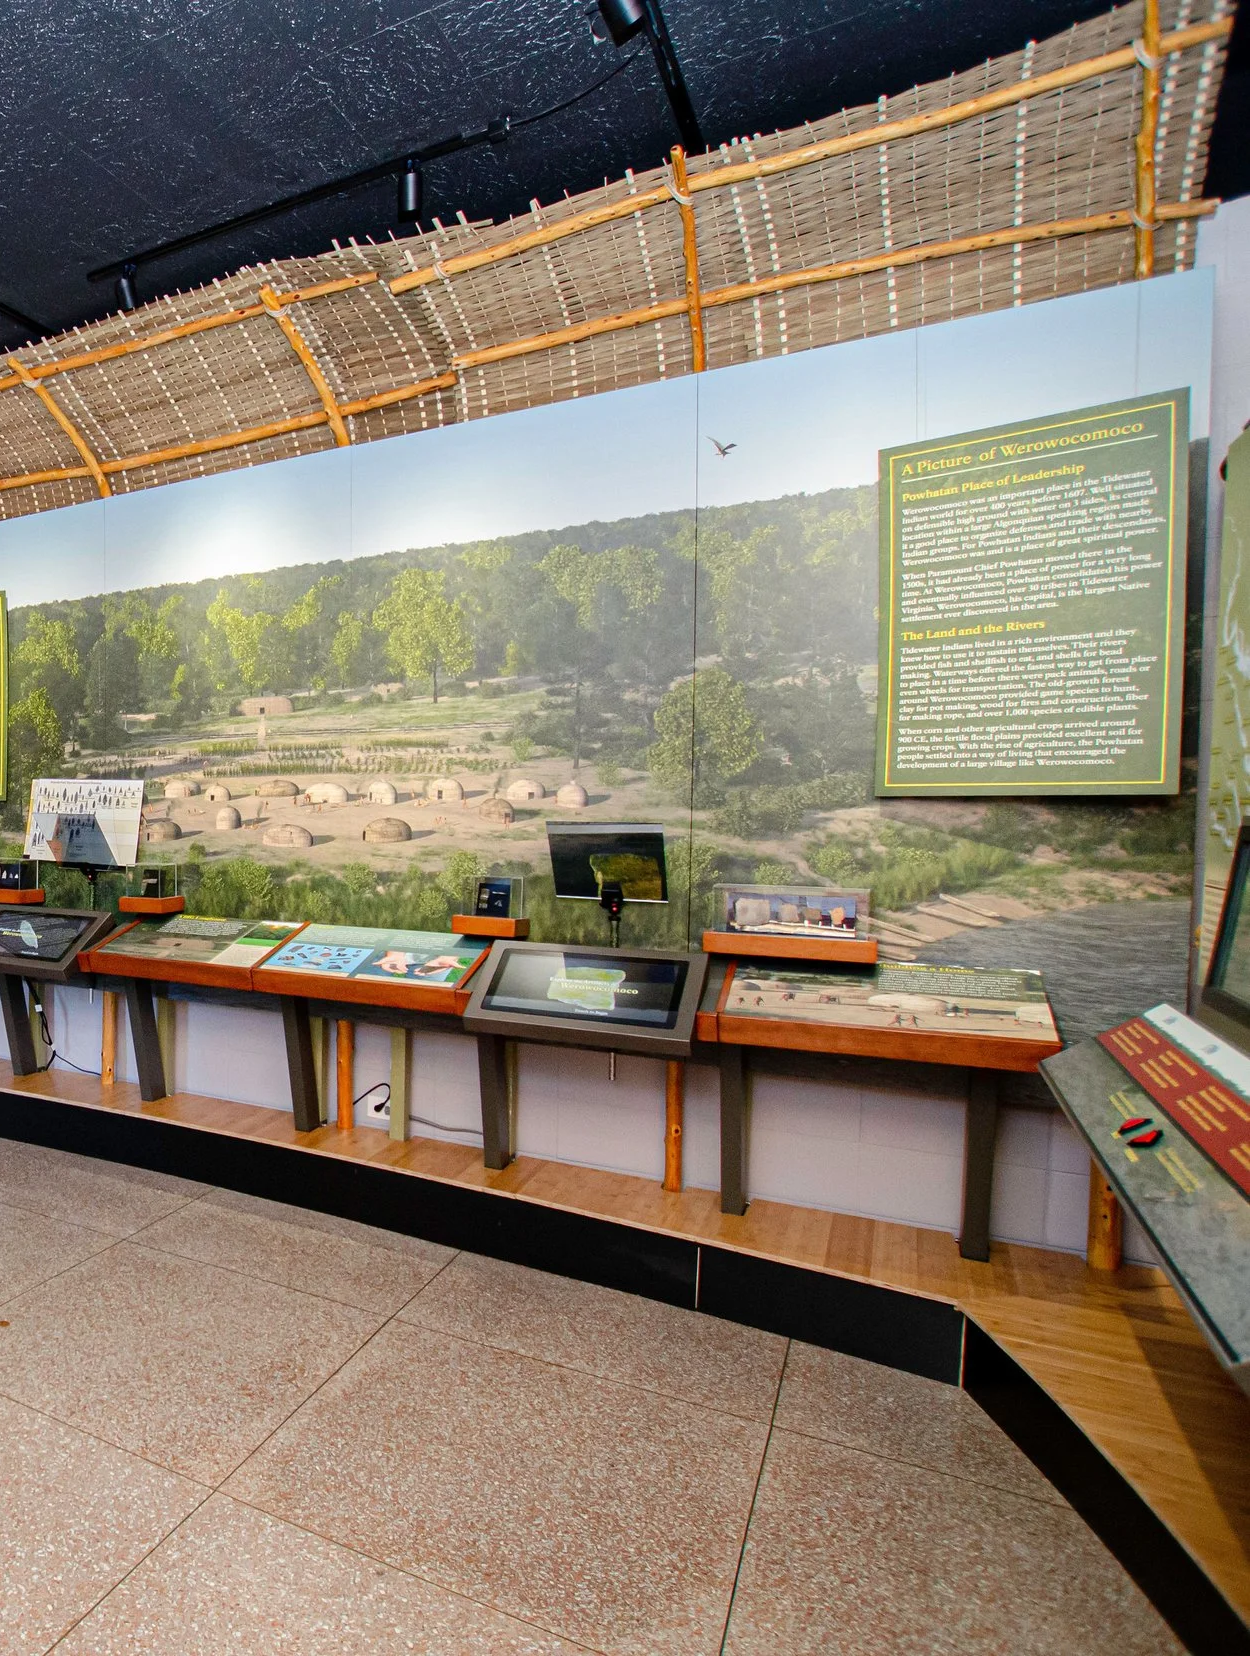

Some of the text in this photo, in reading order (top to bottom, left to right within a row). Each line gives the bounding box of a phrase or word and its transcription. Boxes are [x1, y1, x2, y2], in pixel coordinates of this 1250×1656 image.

[901, 423, 1143, 475] A Picture of Werowocomoco
[902, 501, 966, 516] Werowocomoco
[1000, 486, 1043, 500] important
[1047, 483, 1069, 494] place
[1084, 478, 1098, 486] the
[1102, 470, 1150, 483] Tidewater
[902, 515, 927, 524] Indian
[930, 510, 952, 519] world
[990, 501, 1004, 510] 400
[1008, 499, 1029, 509] years
[1032, 494, 1060, 503] before
[1090, 484, 1110, 494] Well
[1114, 477, 1152, 490] situated
[903, 463, 1084, 502] Powhatan Place of Leadership
[902, 532, 933, 541] location
[936, 527, 961, 536] within
[971, 523, 990, 531] large
[994, 515, 1043, 528] Algonquian
[1047, 509, 1086, 520] speaking
[1090, 504, 1119, 513] region
[1123, 498, 1148, 508] made
[915, 519, 953, 530] defensible
[957, 515, 974, 524] high
[977, 510, 1007, 523] ground
[1010, 506, 1028, 516] with
[1032, 503, 1055, 512] water
[1072, 498, 1079, 506] 3
[1123, 486, 1157, 498] central
[561, 982, 639, 995] Werowocomoco
